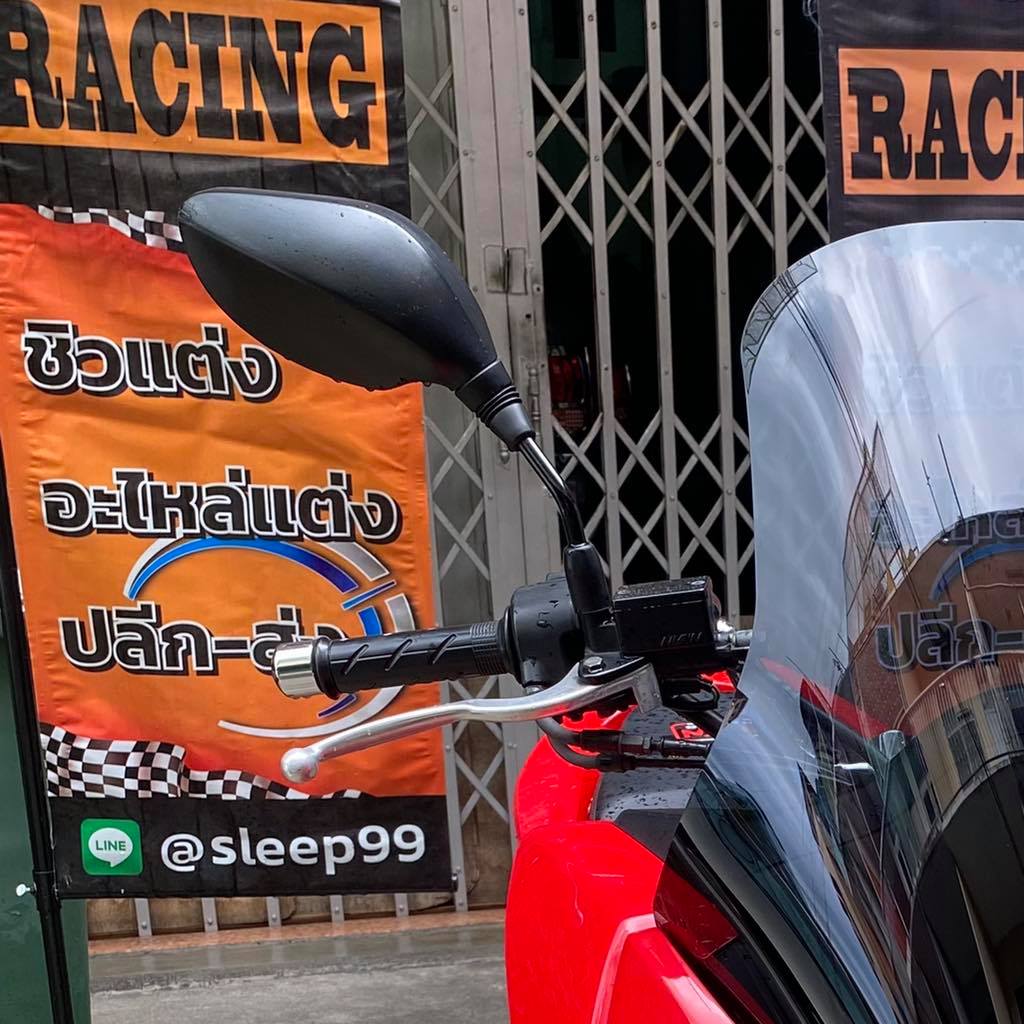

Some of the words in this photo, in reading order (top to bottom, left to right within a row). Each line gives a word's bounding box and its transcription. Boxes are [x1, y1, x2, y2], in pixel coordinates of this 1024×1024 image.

[0, 0, 377, 150] RACING
[40, 466, 402, 540] อะไหล่แต่ง
[95, 839, 127, 852] LINE
[160, 823, 426, 876] @sleep99
